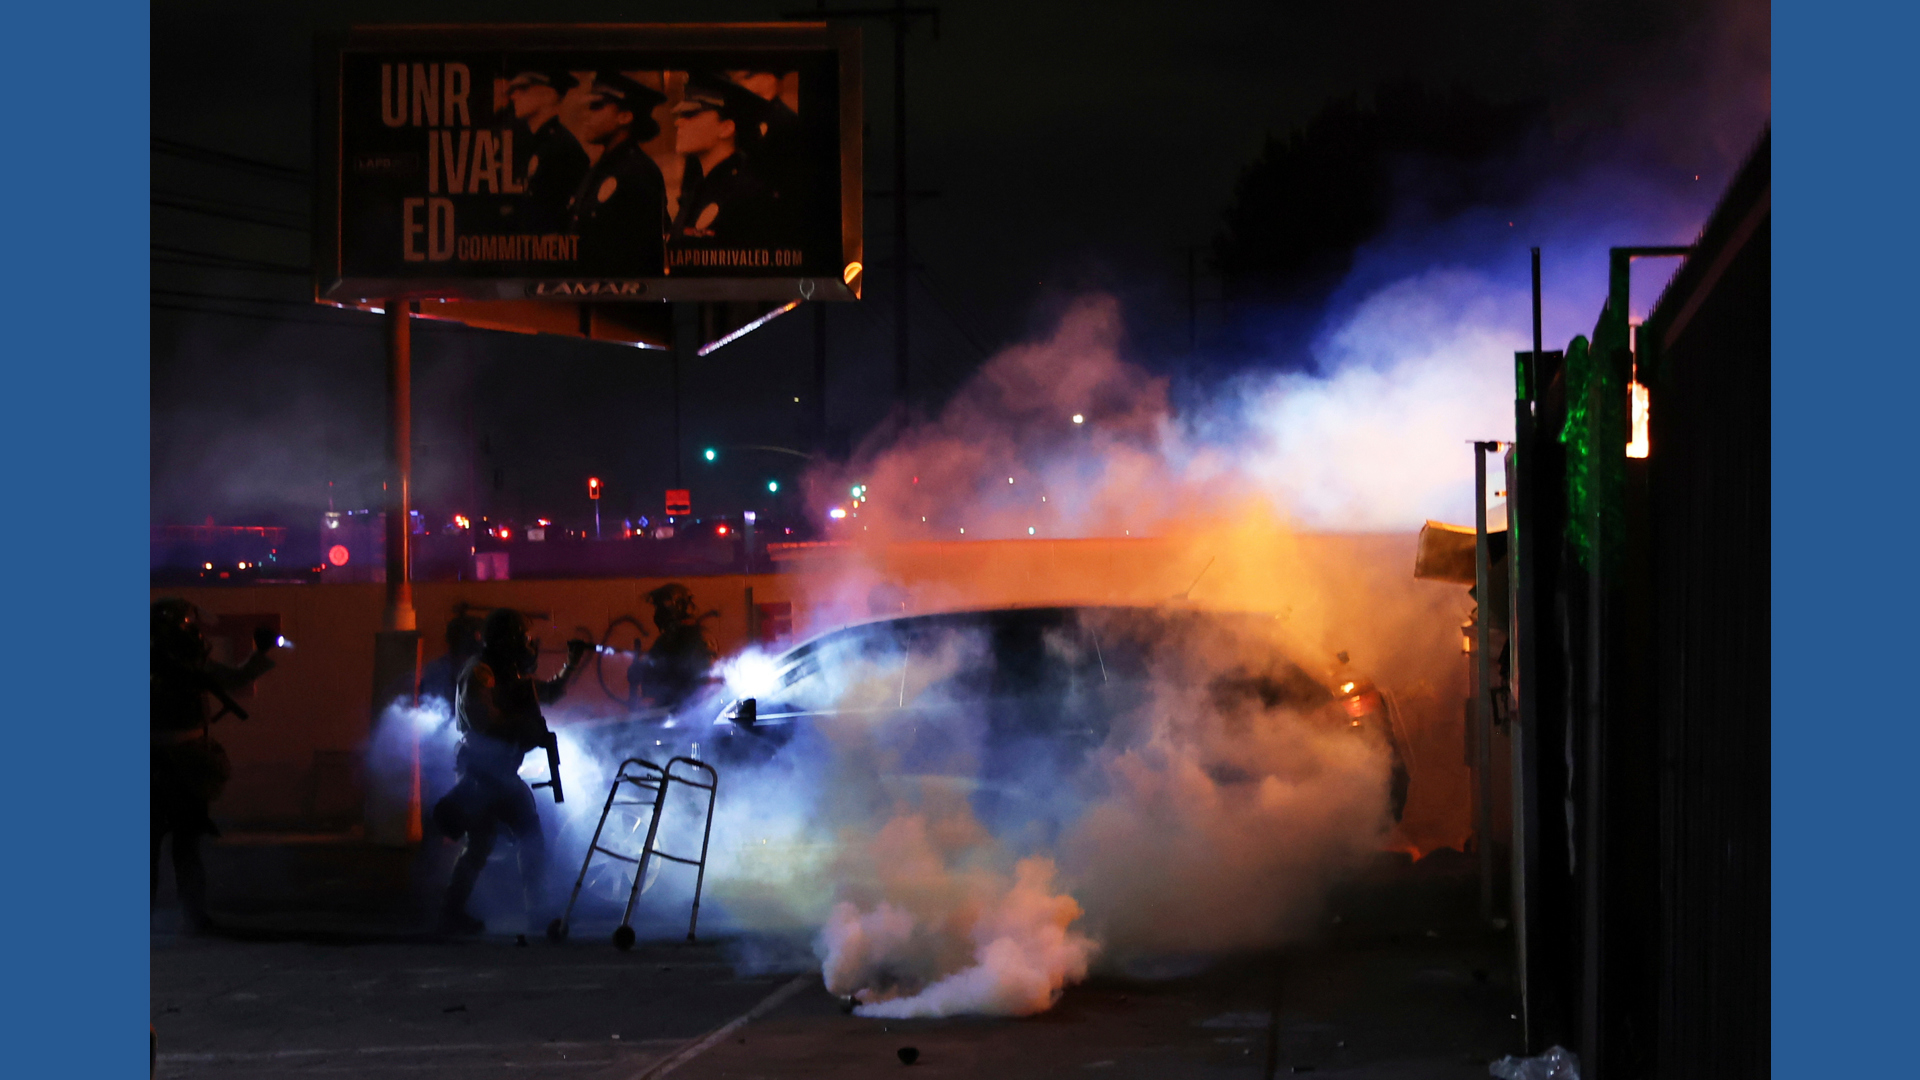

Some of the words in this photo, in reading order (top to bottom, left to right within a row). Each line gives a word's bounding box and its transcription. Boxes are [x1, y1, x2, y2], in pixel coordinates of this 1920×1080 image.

[381, 62, 471, 127] UNR
[428, 128, 524, 194] IVAL
[402, 196, 456, 262] ED
[458, 234, 580, 262] COMMITMENT
[669, 249, 803, 267] LAPDUNRIVALED.COM
[535, 281, 640, 296] LAMAR
